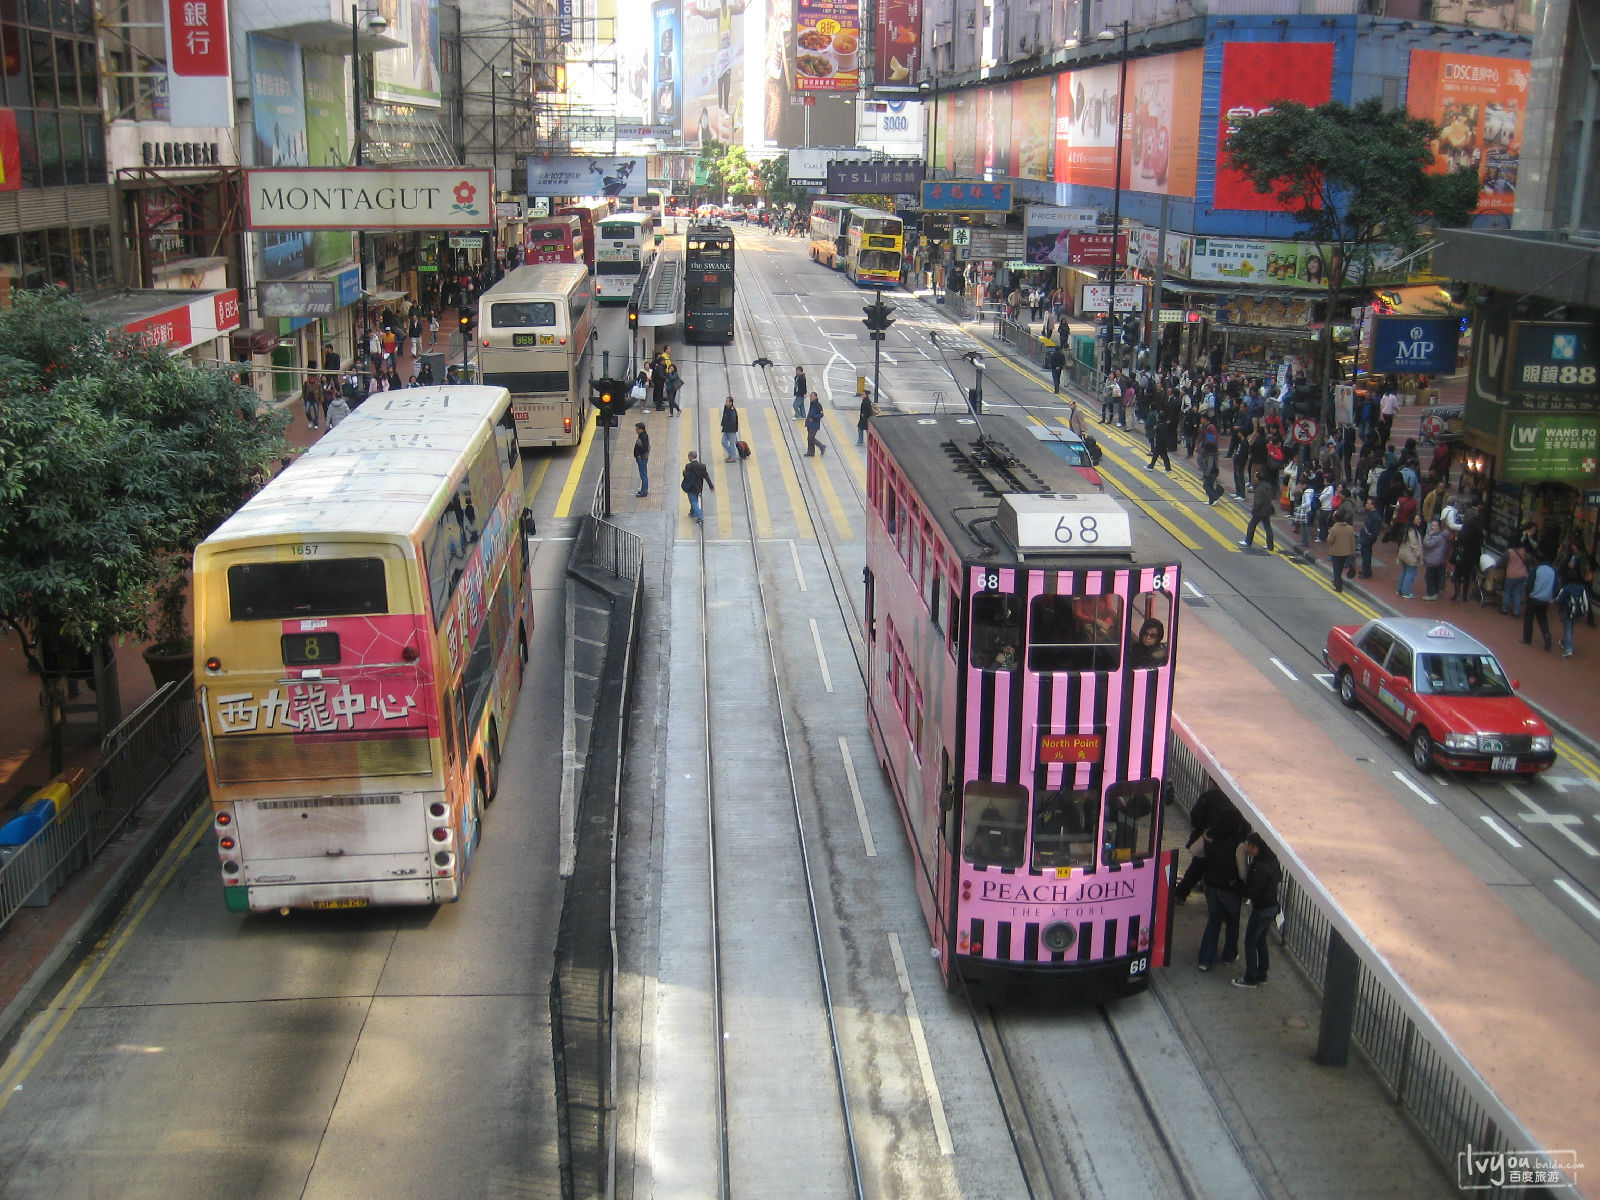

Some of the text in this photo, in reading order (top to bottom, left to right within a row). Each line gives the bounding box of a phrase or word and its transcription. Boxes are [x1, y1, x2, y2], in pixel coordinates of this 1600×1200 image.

[183, 1, 211, 55] 銀行
[883, 116, 907, 131] SOGO
[837, 173, 872, 183] TSL
[260, 187, 440, 211] MONTAGUT
[703, 262, 731, 270] SWANK
[225, 299, 240, 319] BEA
[307, 303, 333, 313] FIRE
[1395, 341, 1434, 360] MP
[1522, 365, 1597, 385] 眼鏡88
[1518, 427, 1538, 443] W
[1545, 428, 1597, 438] WANG PO
[1054, 515, 1099, 544] 68
[292, 545, 319, 555] 1657
[977, 573, 998, 589] 68
[1152, 574, 1170, 590] 68
[305, 637, 320, 659] 8
[216, 684, 417, 733] 西九龍中心
[1042, 738, 1099, 749] North Point
[981, 878, 1136, 901] PEACH JOHN
[1010, 906, 1106, 917] THE STORE
[1129, 957, 1147, 975] 68
